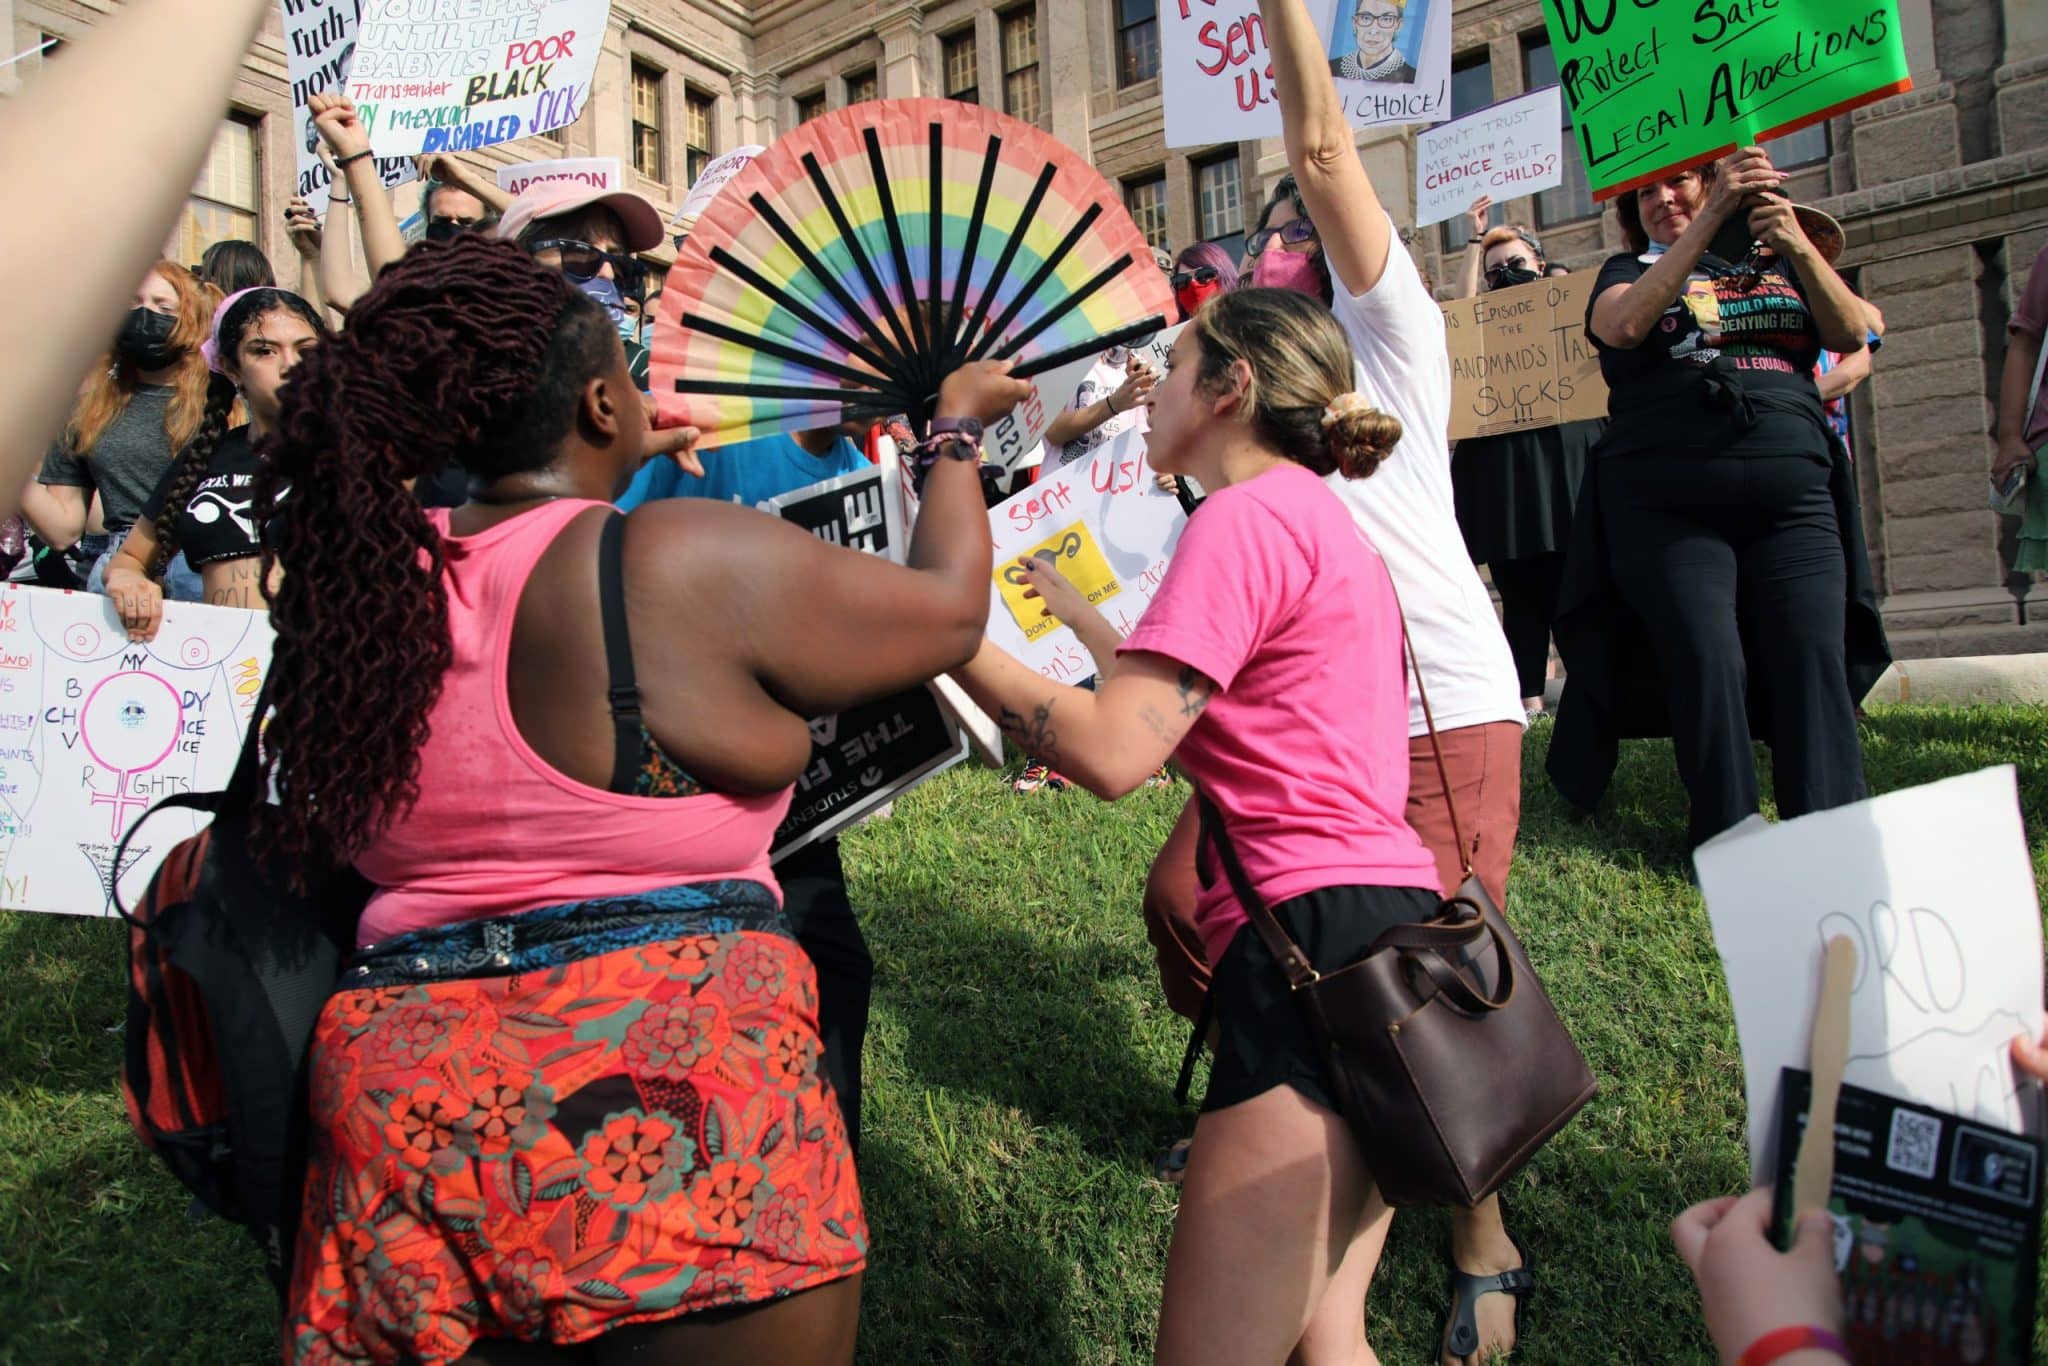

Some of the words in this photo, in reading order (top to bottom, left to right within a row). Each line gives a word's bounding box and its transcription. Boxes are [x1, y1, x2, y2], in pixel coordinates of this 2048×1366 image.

[357, 23, 463, 51] UNTIL
[469, 13, 542, 48] THE
[1195, 13, 1268, 76] Sen
[350, 51, 448, 79] BABY
[450, 50, 490, 76] IS
[505, 31, 576, 69] POOR
[352, 82, 452, 100] Transgender
[467, 63, 554, 106] BLACK
[1356, 80, 1445, 119] CHOICE!
[421, 115, 521, 153] DISABLED
[529, 82, 586, 134] SICK
[1481, 109, 1535, 131] TRUST
[1425, 159, 1493, 190] CHOICE
[1503, 144, 1542, 165] BUT
[1426, 157, 1450, 174] ME
[1458, 143, 1495, 160] WITH
[1503, 136, 1515, 146] A
[1430, 187, 1465, 206] WITH
[1473, 181, 1483, 190] A
[1490, 153, 1557, 186] CHILD?
[1474, 301, 1535, 324] EPISODE
[1547, 287, 1571, 307] OF
[1718, 299, 1763, 317] WOULD
[1720, 315, 1777, 333] DENYING
[1498, 323, 1523, 336] THE
[1453, 343, 1548, 380] ANDMAID'S
[1550, 323, 1600, 363] TAL
[1473, 376, 1574, 417] SUCKS
[995, 413, 1024, 467] 021
[1025, 618, 1053, 638] DON'T
[1087, 590, 1103, 603] ON
[1104, 581, 1119, 595] ME
[119, 653, 148, 671] MY
[840, 712, 914, 766] THE
[777, 780, 859, 838] STUDENTS
